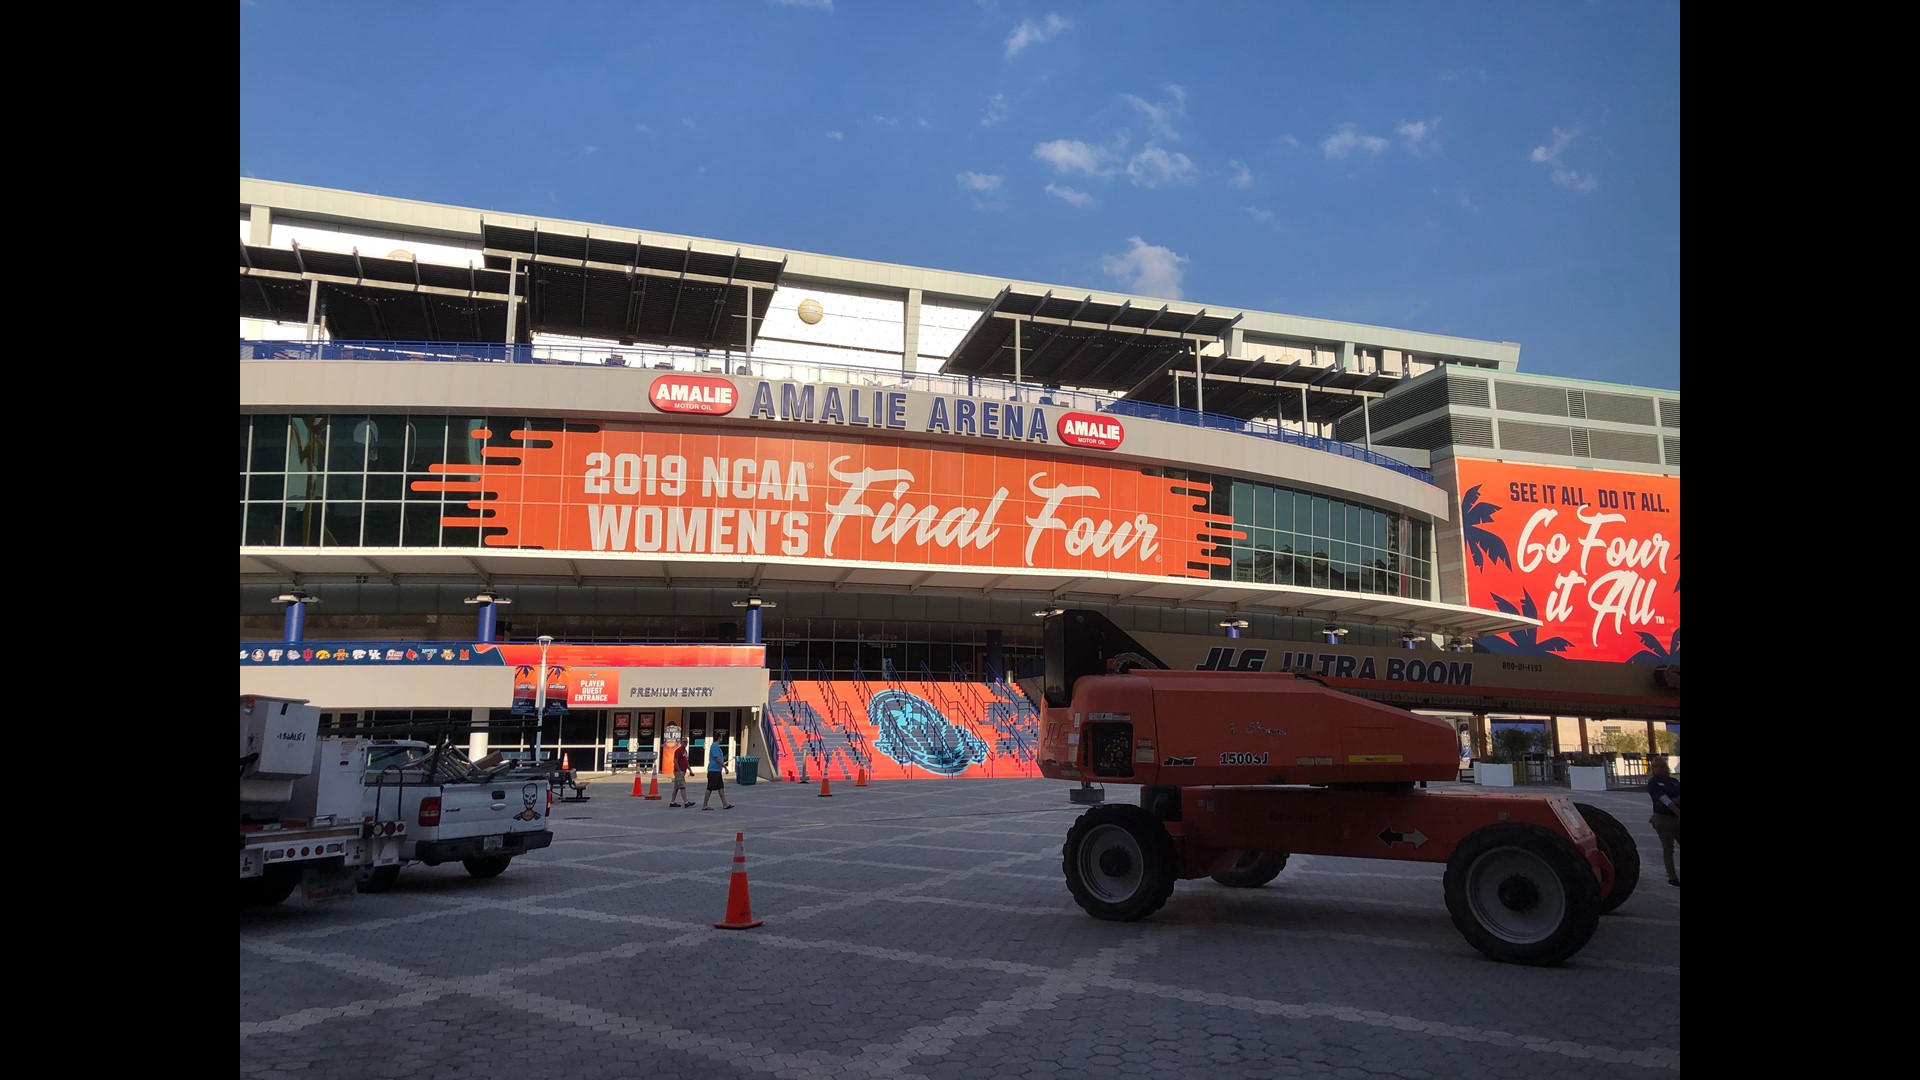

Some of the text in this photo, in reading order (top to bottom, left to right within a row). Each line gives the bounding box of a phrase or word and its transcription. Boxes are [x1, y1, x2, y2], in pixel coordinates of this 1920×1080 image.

[656, 383, 733, 404] AMALIE
[750, 380, 1049, 443] AMALIE ARENA
[1064, 419, 1120, 440] AMALIE
[584, 452, 809, 502] 2019 NCAA
[1510, 481, 1670, 513] SEE IT ALL. DO IT ALL.
[588, 504, 809, 556] WOMEN'S
[824, 455, 1160, 567] Final Four
[1517, 504, 1671, 576] Go Four
[1545, 569, 1587, 622] it
[1588, 570, 1658, 647] All
[1194, 646, 1474, 687] JLG ULTRA BOOM
[574, 694, 608, 702] ENTRANCE
[630, 687, 714, 698] PREMIUM ENTRY
